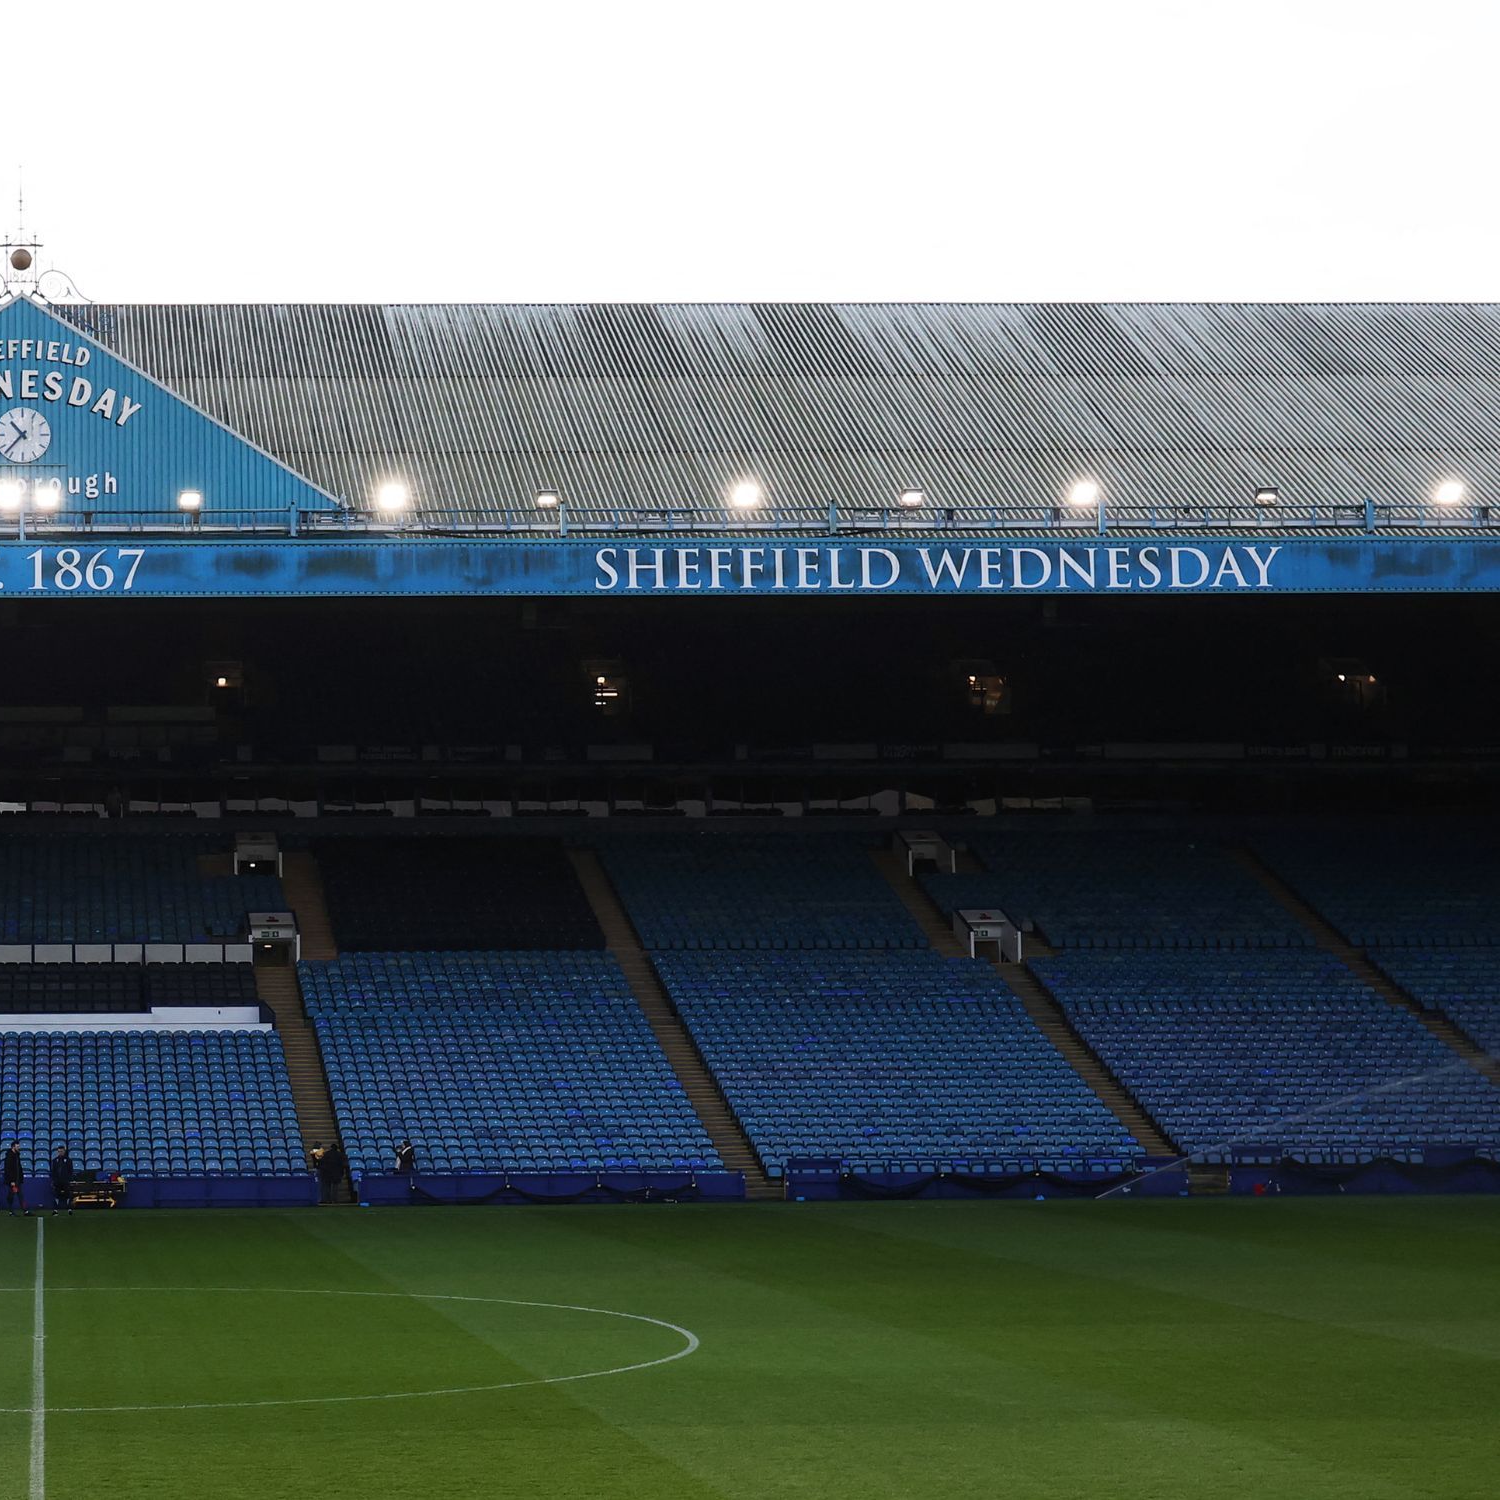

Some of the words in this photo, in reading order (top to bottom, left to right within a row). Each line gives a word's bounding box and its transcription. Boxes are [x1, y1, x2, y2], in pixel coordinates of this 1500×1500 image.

[26, 548, 146, 591] 1867
[595, 547, 901, 590] SHEFFIELD
[915, 546, 1283, 589] WEDNESDAY
